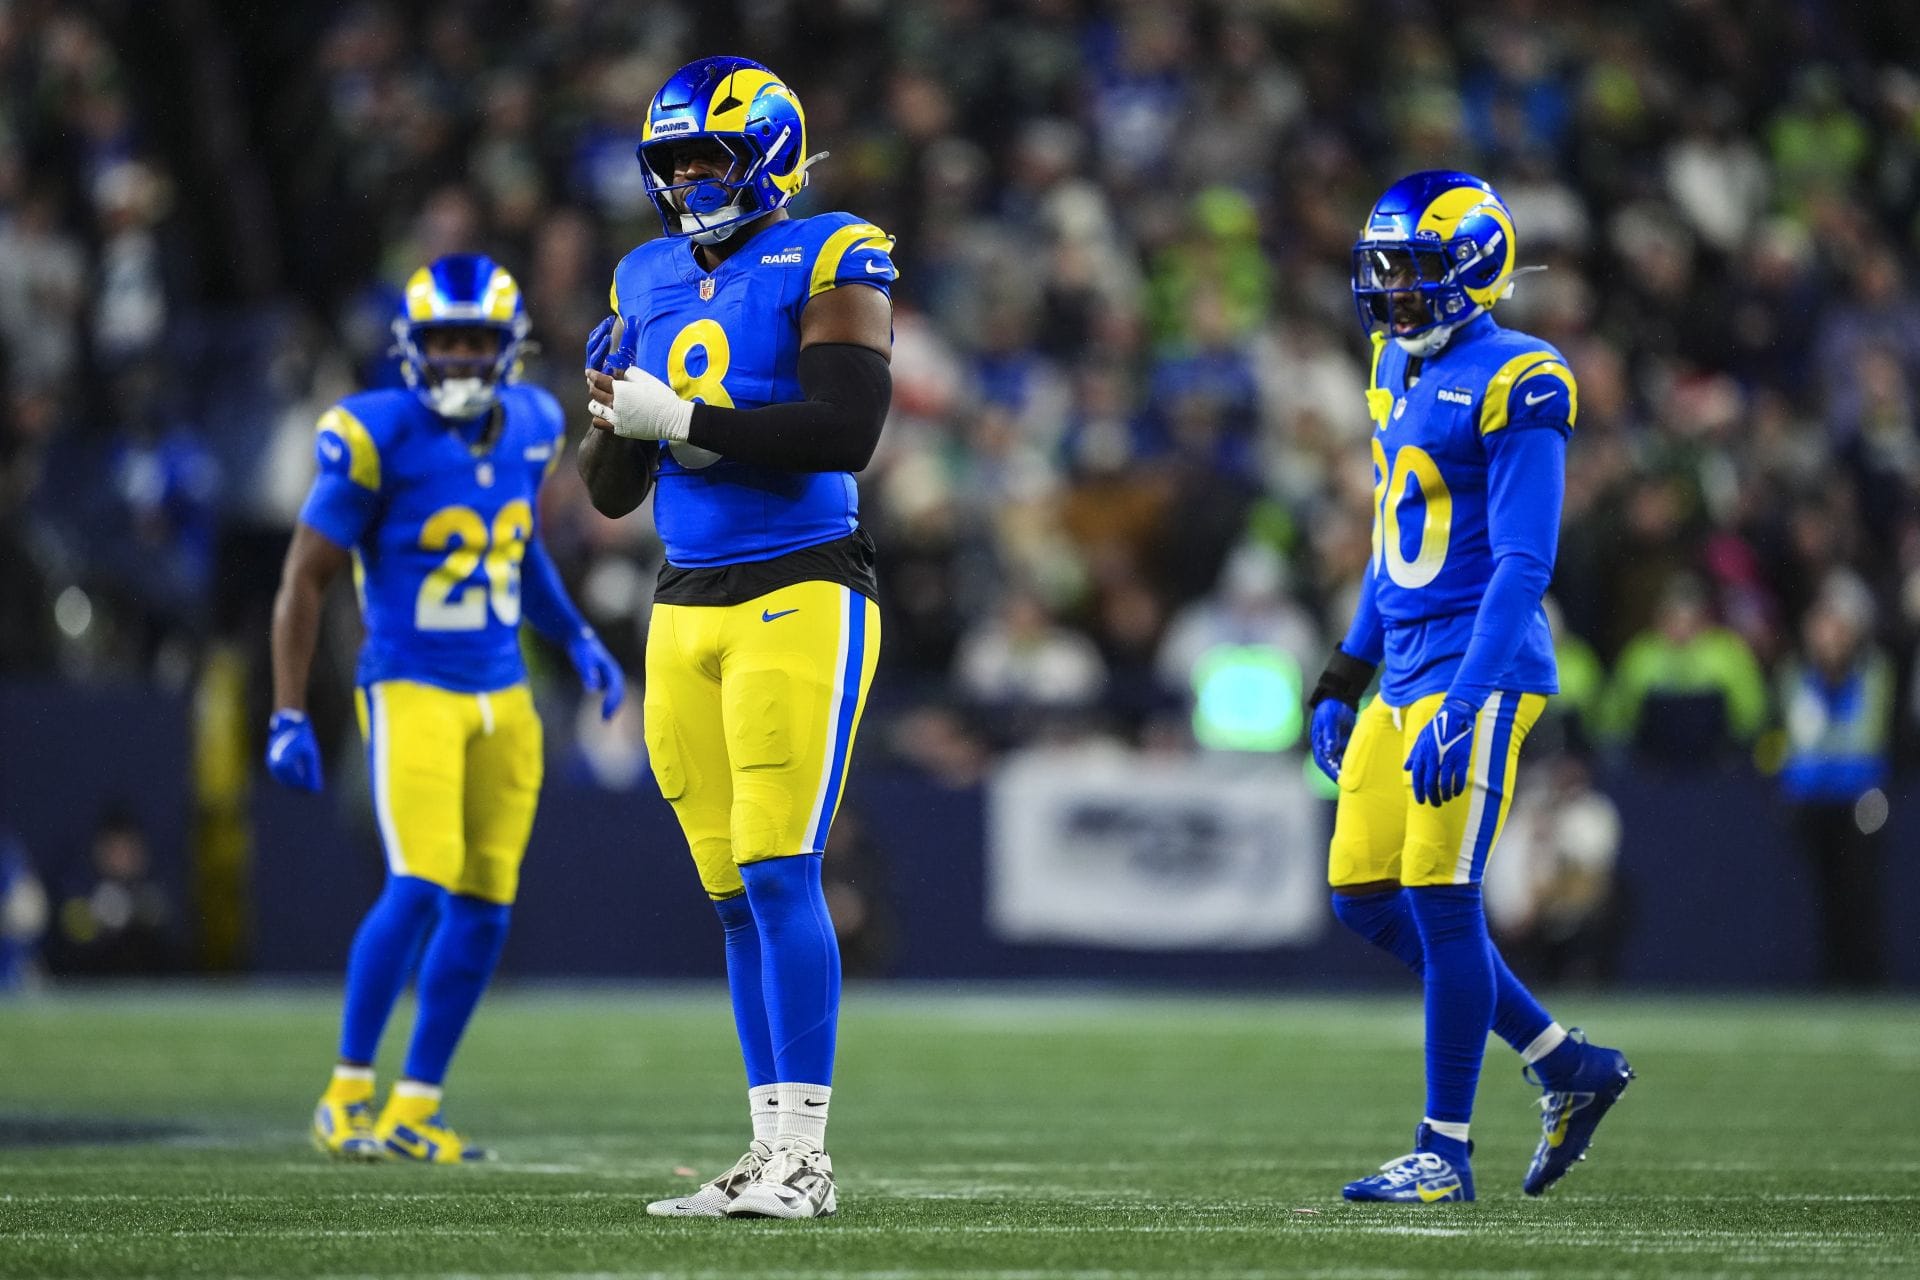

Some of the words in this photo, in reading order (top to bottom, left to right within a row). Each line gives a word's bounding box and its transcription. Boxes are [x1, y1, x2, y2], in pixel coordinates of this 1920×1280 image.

[654, 121, 690, 134] RAMS
[761, 253, 802, 264] RAMS
[667, 318, 735, 470] 8
[1437, 389, 1472, 406] RAMS
